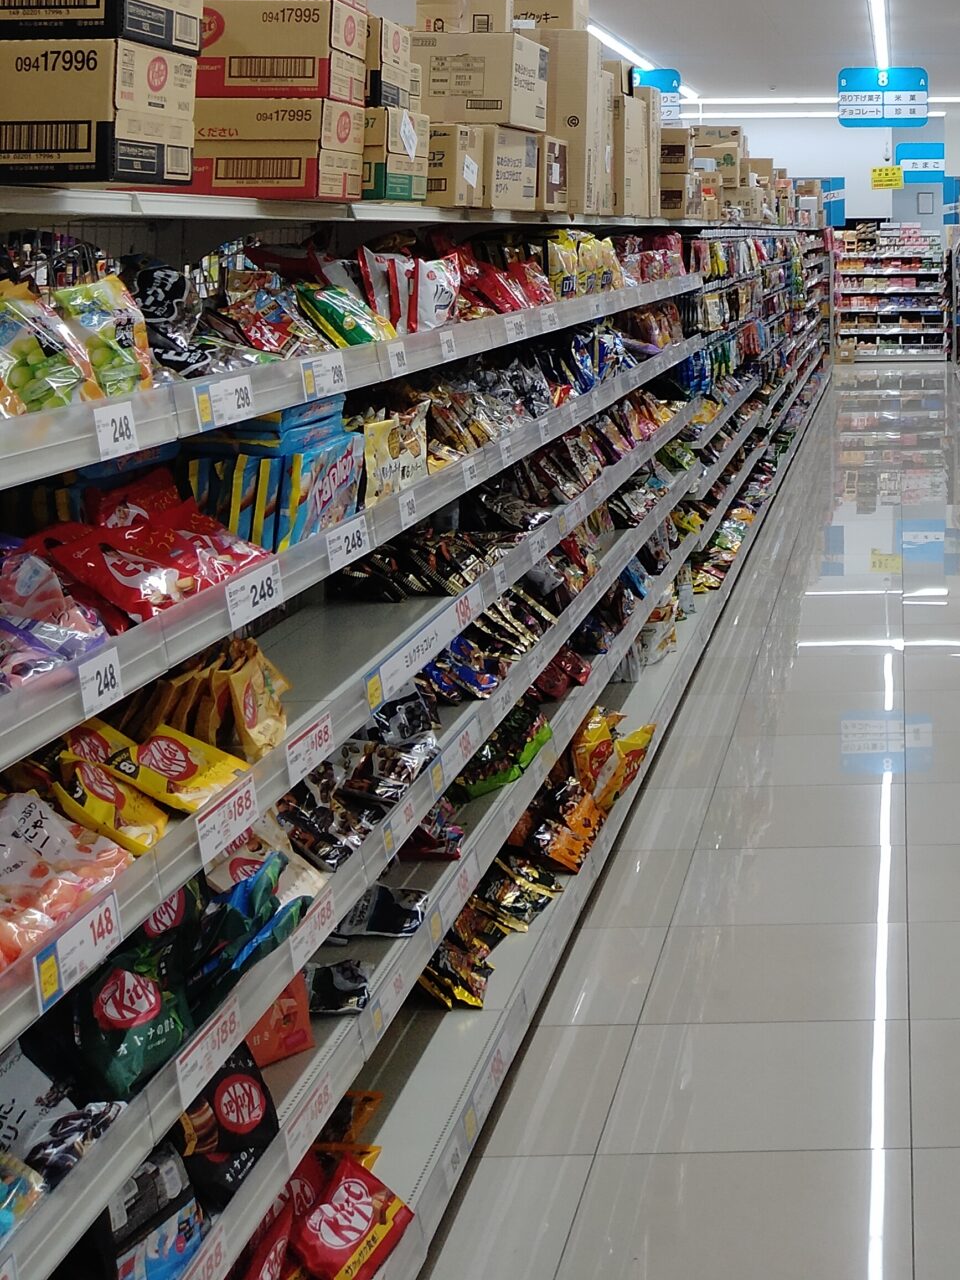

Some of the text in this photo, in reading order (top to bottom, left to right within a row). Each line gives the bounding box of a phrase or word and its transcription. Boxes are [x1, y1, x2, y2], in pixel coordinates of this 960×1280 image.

[261, 7, 320, 24] 09417995
[15, 49, 98, 73] 09417996
[672, 79, 678, 87] A
[878, 71, 888, 86] 8
[841, 94, 881, 102] 吊り下げ菓子
[894, 94, 917, 102] 米菓
[256, 108, 312, 123] 09417995
[841, 108, 881, 116] チョコレート
[894, 107, 917, 115] 珍味
[197, 127, 239, 137] ください
[234, 386, 251, 410] 298
[111, 415, 132, 443] 248
[343, 530, 363, 555] 248
[251, 577, 274, 608] 248
[96, 663, 117, 697] 248
[119, 761, 136, 774] 8
[89, 906, 114, 947] 148
[222, 1082, 263, 1124] KitKat
